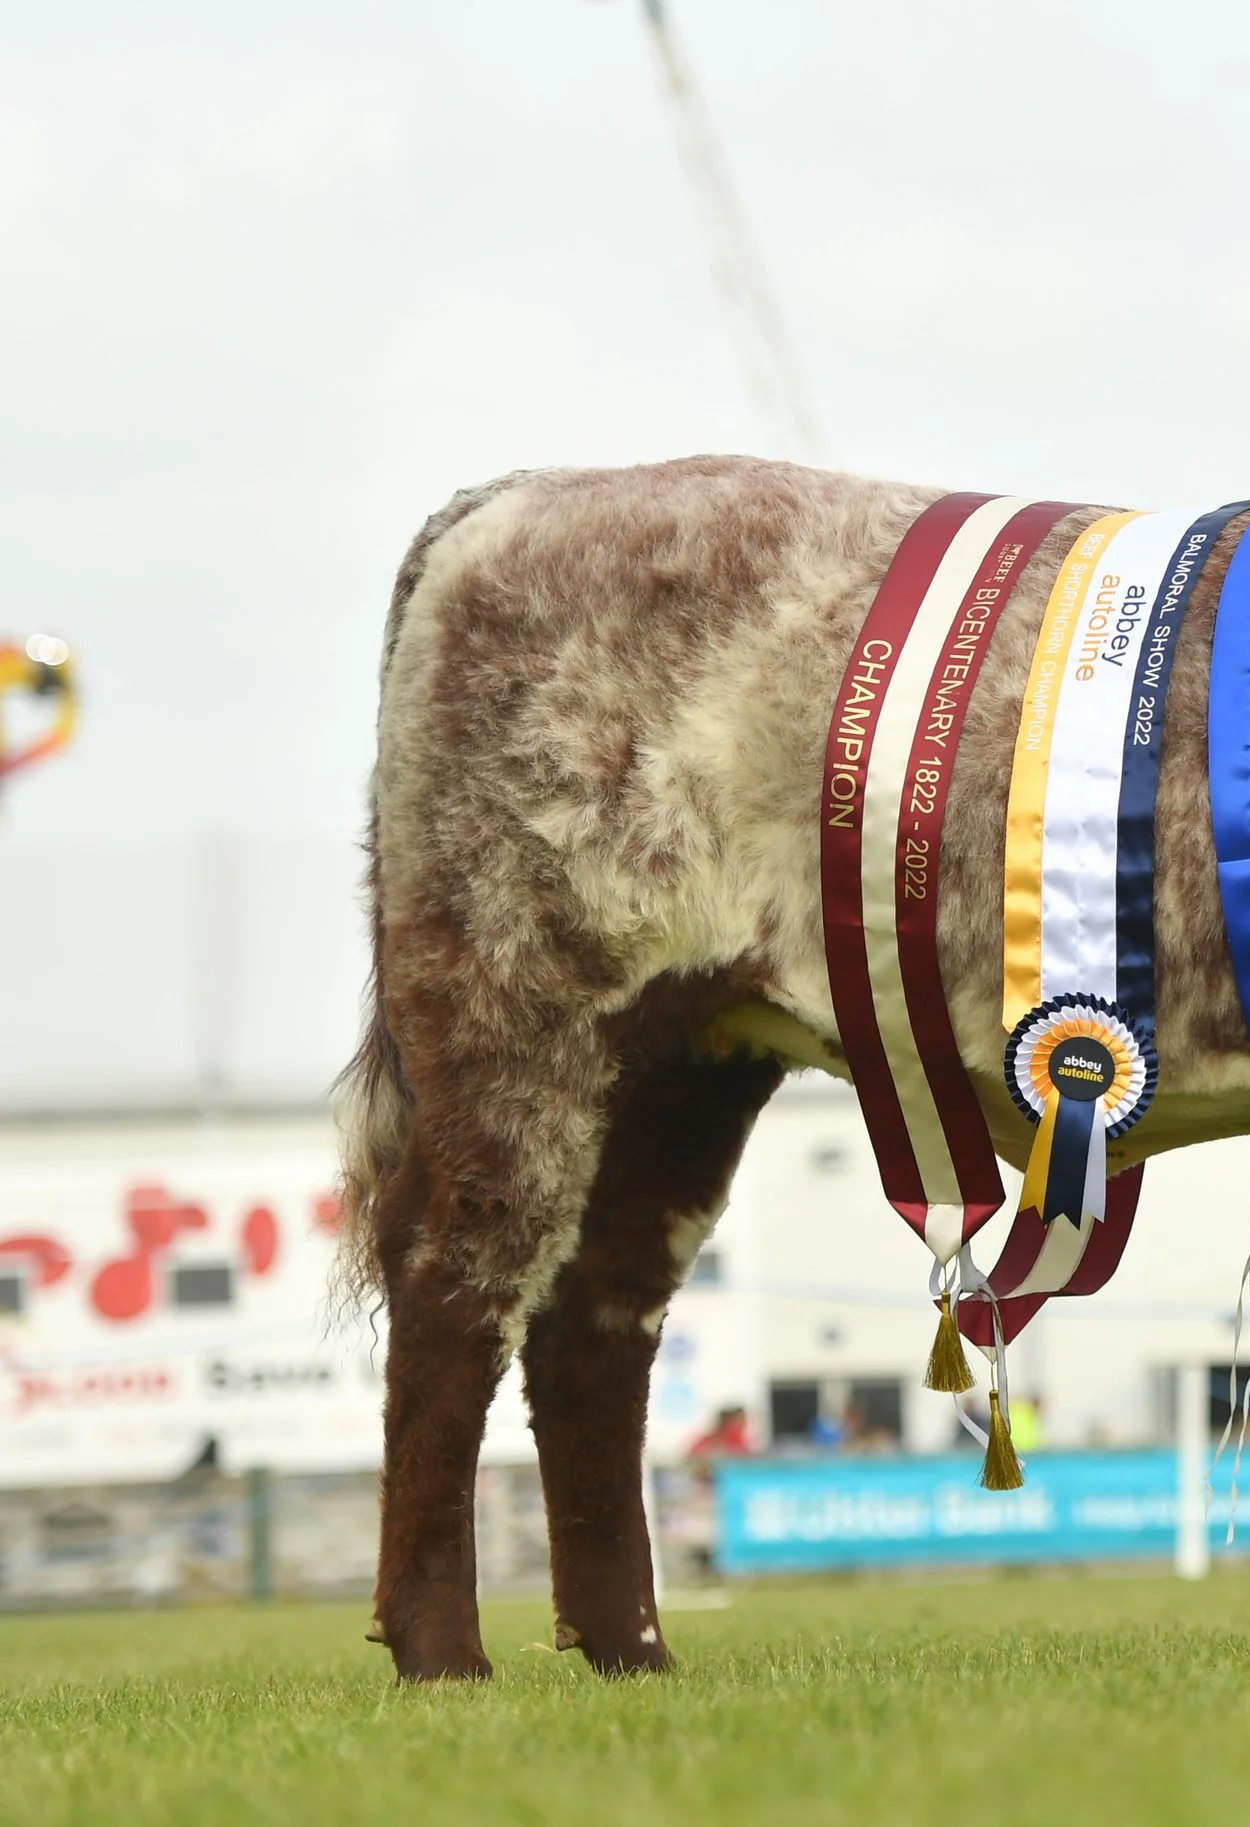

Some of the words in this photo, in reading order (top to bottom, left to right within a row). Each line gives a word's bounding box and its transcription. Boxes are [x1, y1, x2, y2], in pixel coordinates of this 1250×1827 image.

[993, 554, 1018, 583] BEEF
[1159, 533, 1207, 619] BALMORAL
[1046, 562, 1088, 655] SHORTHORN
[1075, 574, 1121, 682] autoline
[1102, 585, 1146, 667] abbey
[924, 588, 1001, 749] BICENTENARY
[1144, 624, 1171, 688] SHOW
[828, 639, 892, 829] CHAMPION
[1025, 661, 1056, 751] CHAMPION
[1133, 696, 1155, 746] 2022
[910, 755, 943, 814] 1822
[904, 838, 930, 900] 2022
[1057, 1066, 1104, 1083] autoline
[1063, 1055, 1102, 1073] abbey
